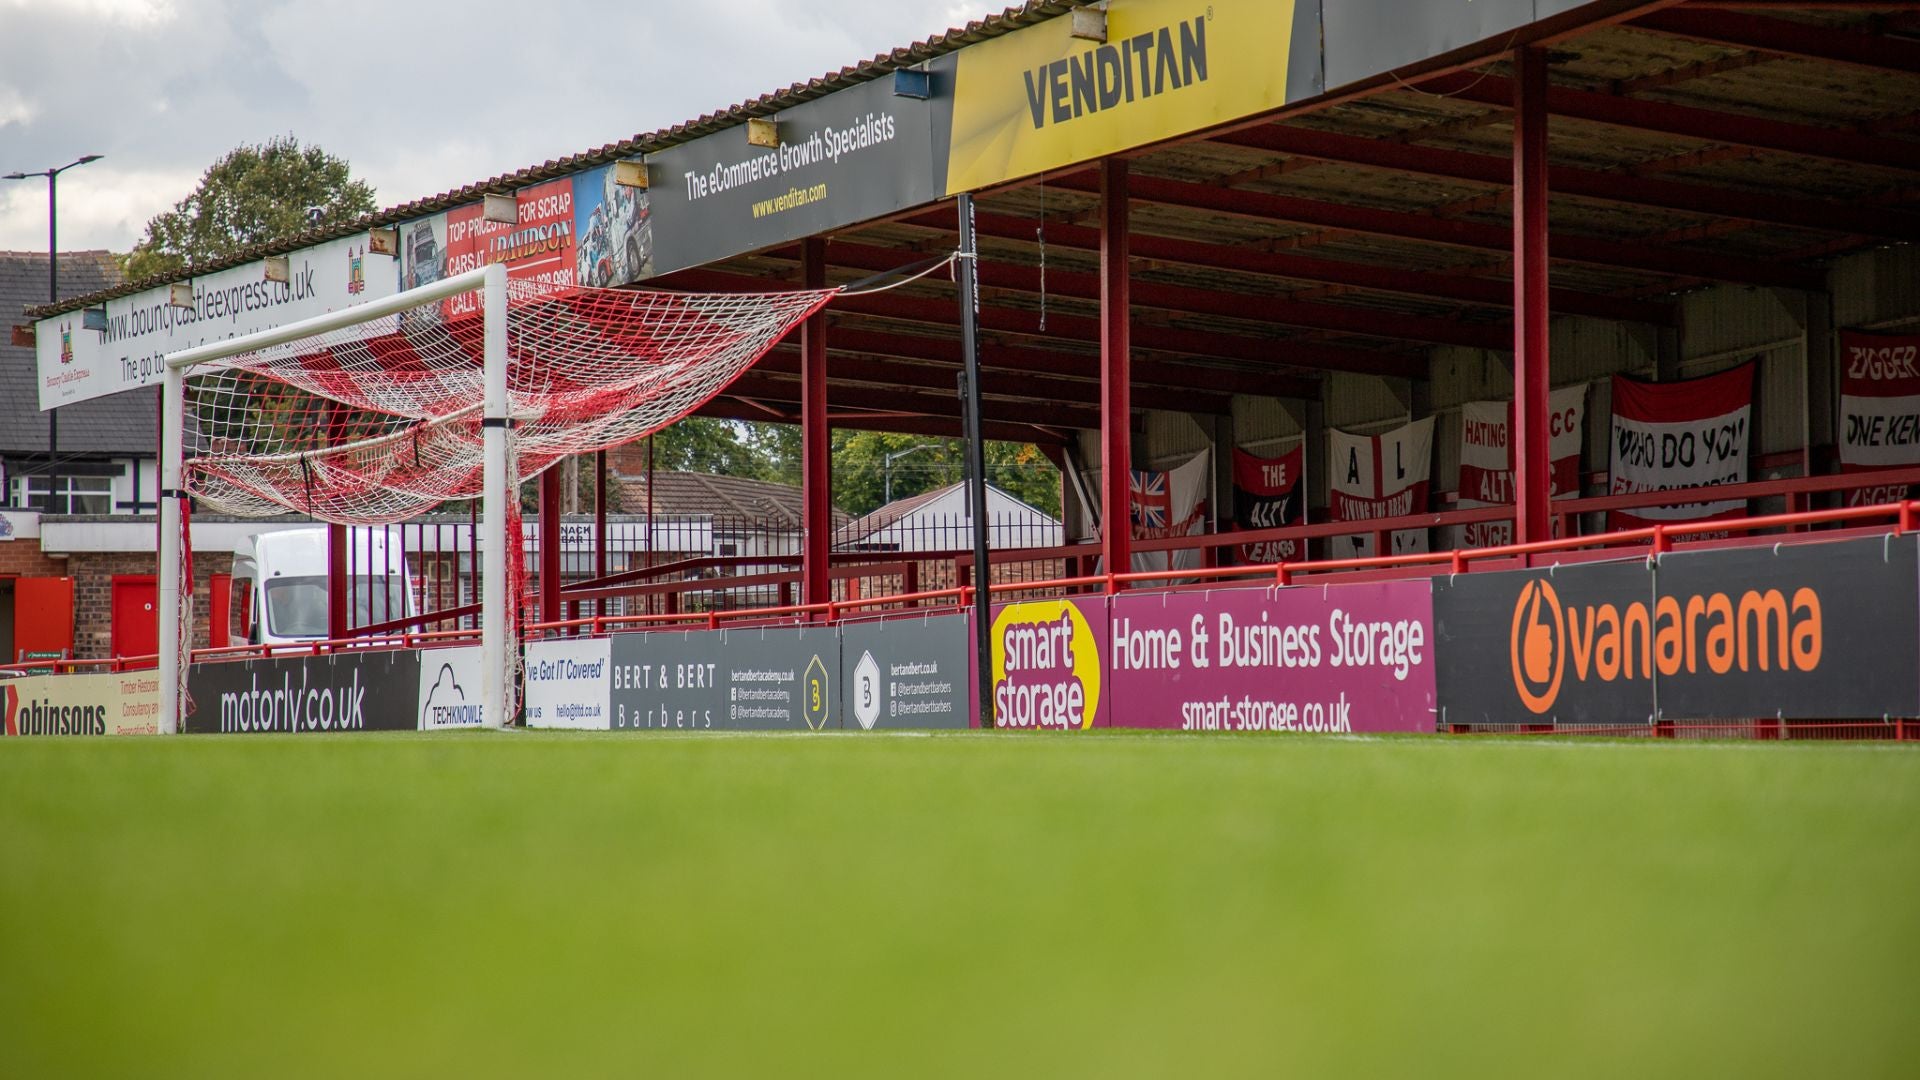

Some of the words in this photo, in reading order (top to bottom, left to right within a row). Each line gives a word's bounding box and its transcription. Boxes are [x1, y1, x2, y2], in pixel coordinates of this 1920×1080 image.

[1023, 15, 1208, 129] VENDITAN
[684, 171, 707, 200] The
[709, 158, 778, 193] eCommerce
[779, 131, 824, 173] Growth
[825, 111, 895, 164] Specialists
[449, 221, 466, 243] TOP
[518, 200, 536, 224] FOR
[538, 192, 571, 219] SCRAP
[752, 182, 827, 219] www.venditan.com
[496, 220, 573, 264] DAVIDSON
[448, 252, 475, 276] CARS
[476, 250, 485, 269] AT
[451, 292, 476, 315] CALL
[120, 356, 137, 382] The
[140, 354, 151, 384] go
[154, 349, 165, 374] to
[1465, 420, 1506, 448] HATING
[1662, 431, 1695, 468] DO
[1261, 463, 1287, 488] THE
[1347, 446, 1360, 485] A
[1250, 496, 1290, 528] ALTY
[560, 526, 592, 535] NACK
[1464, 523, 1508, 547] SINCE
[1005, 615, 1073, 671] smart
[1112, 617, 1181, 670] Home
[1190, 613, 1210, 668] &
[1218, 610, 1321, 669] Business
[1330, 608, 1424, 681] Storage
[1567, 587, 1823, 682] vanarama
[540, 660, 555, 681] Got
[556, 659, 565, 680] IT
[614, 665, 651, 689] BERT
[659, 664, 668, 689] &
[677, 663, 716, 688] BERT
[890, 660, 938, 676] bertandbert.co.uk
[221, 667, 365, 733] motorly.co.uk
[432, 704, 483, 725] TECHKNOWLE
[534, 706, 542, 718] us
[618, 703, 711, 728] Barbers
[996, 675, 1083, 731] storage
[1181, 691, 1351, 734] smart-storage.co.uk
